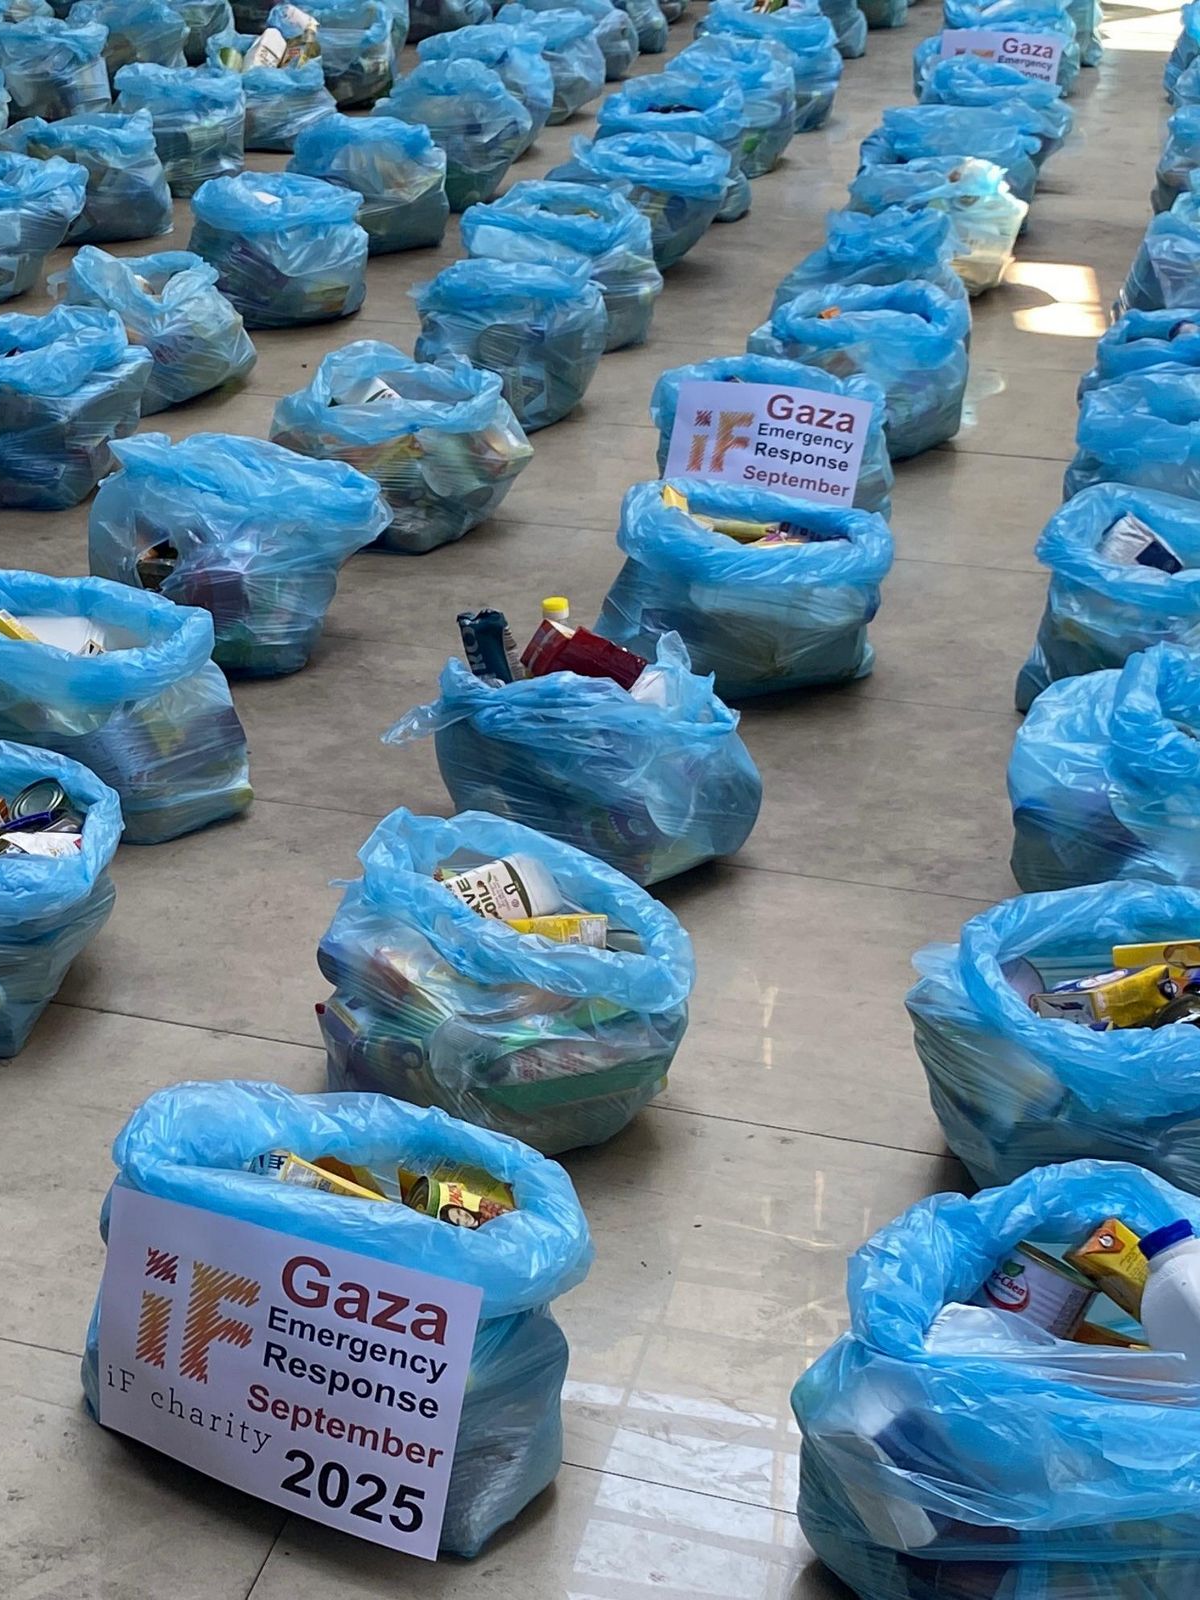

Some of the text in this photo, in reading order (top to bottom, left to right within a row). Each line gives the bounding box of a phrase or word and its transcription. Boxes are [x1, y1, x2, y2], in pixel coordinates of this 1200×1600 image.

[998, 55, 1053, 70] Emergency
[1002, 37, 1053, 58] Gaza
[757, 423, 854, 454] Emergency
[767, 394, 855, 433] Gaza
[743, 465, 850, 497] September
[754, 442, 849, 472] Response
[281, 1256, 448, 1346] Gaza
[267, 1305, 448, 1384] Emergency
[106, 1364, 272, 1454] iF charity
[263, 1341, 439, 1419] Response
[247, 1384, 444, 1468] September
[280, 1448, 426, 1534] 2025
